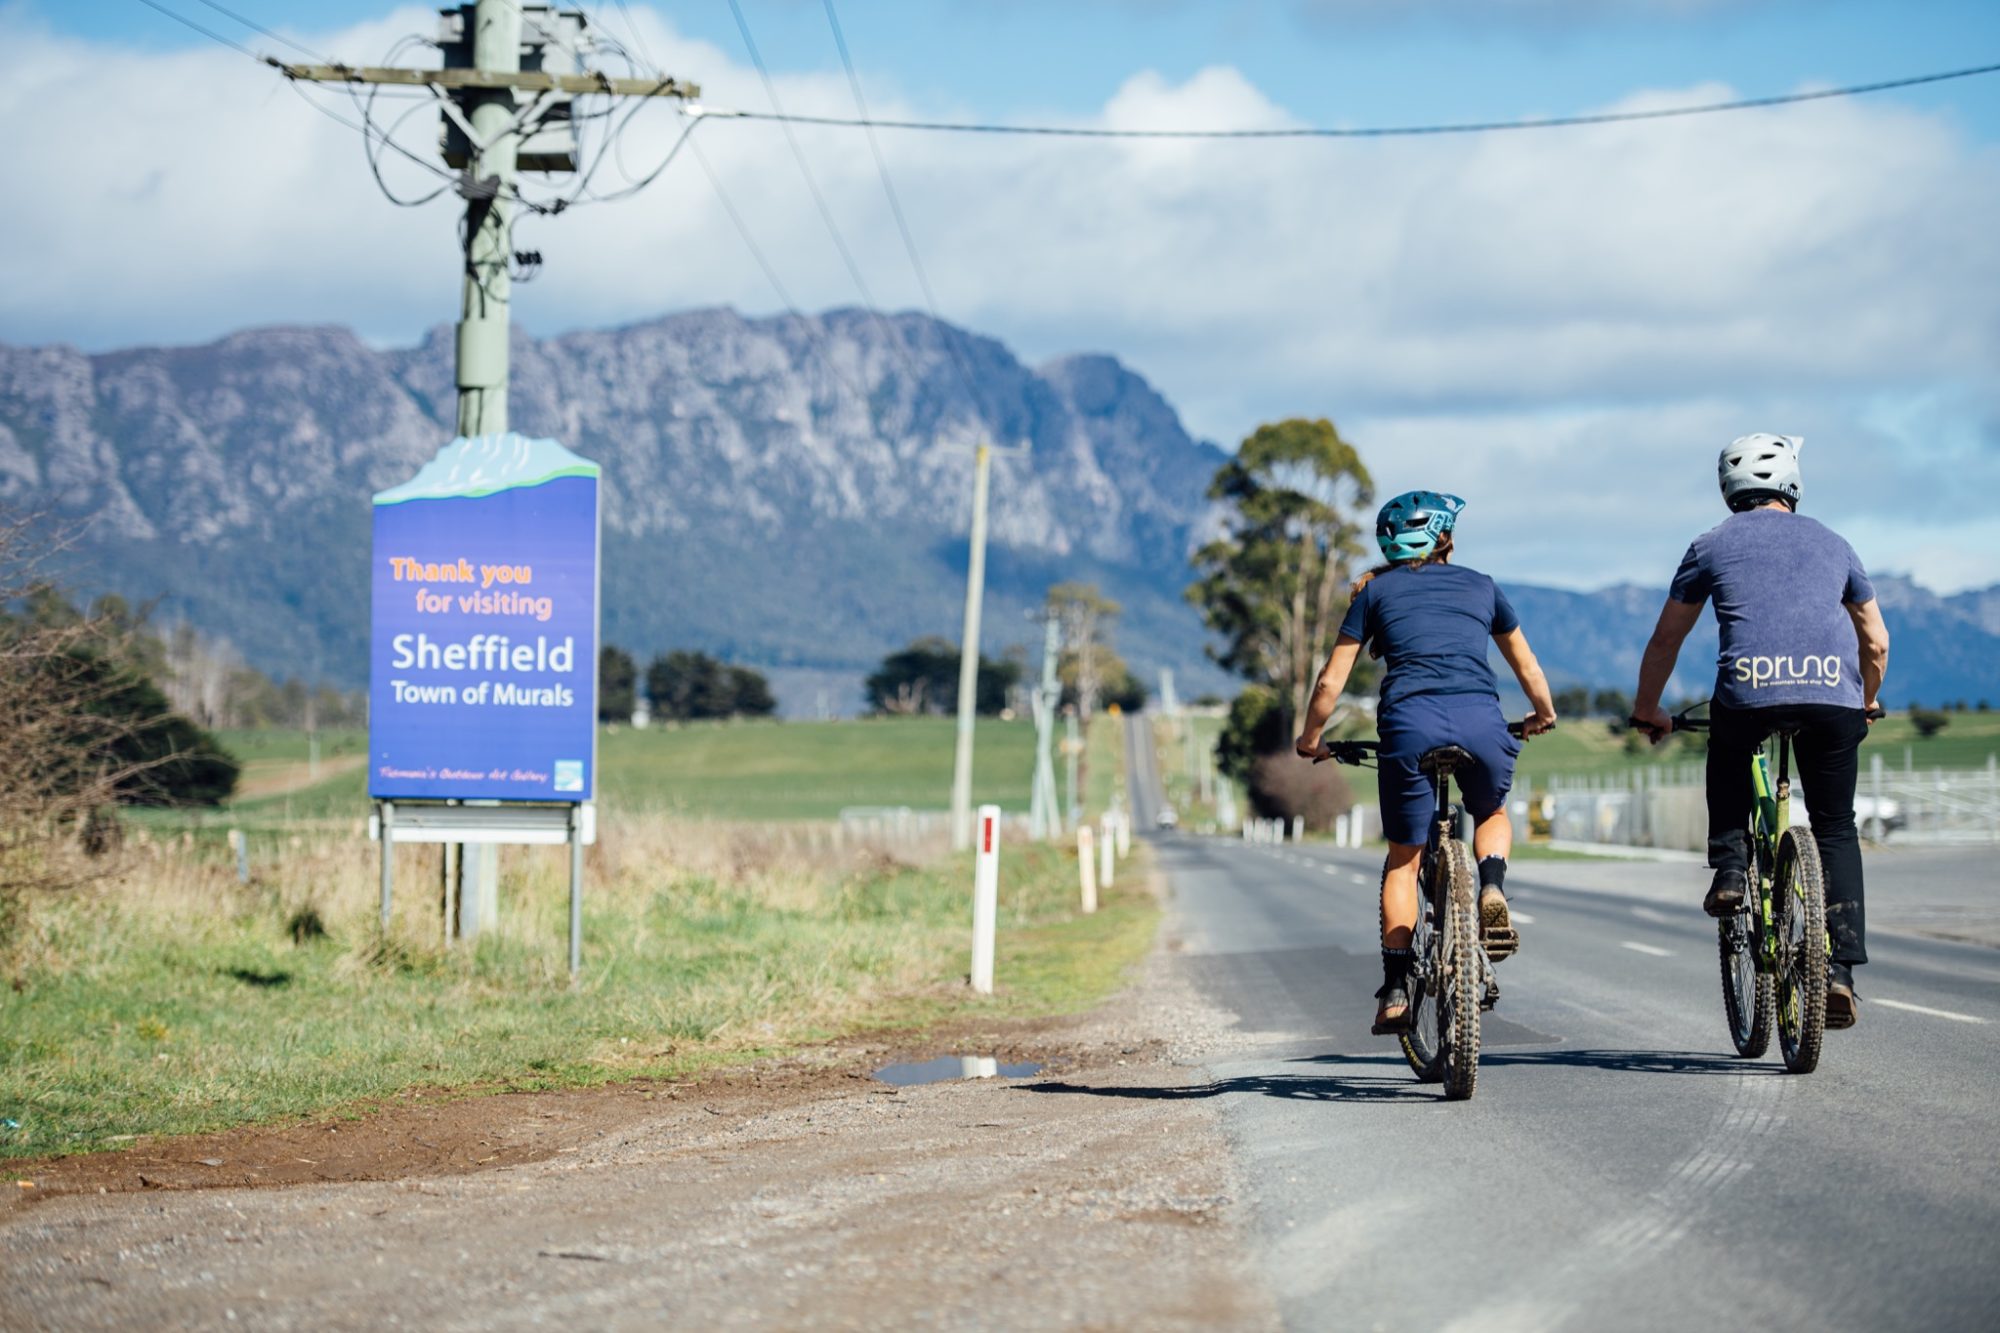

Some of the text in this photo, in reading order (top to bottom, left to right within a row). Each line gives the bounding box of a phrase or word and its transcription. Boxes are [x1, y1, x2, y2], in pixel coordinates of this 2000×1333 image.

[390, 557, 532, 589] Thank you
[416, 588, 553, 621] for visiting
[391, 633, 574, 673] Sheffield
[1735, 655, 1841, 689] sprung
[391, 680, 574, 707] Town of Murals
